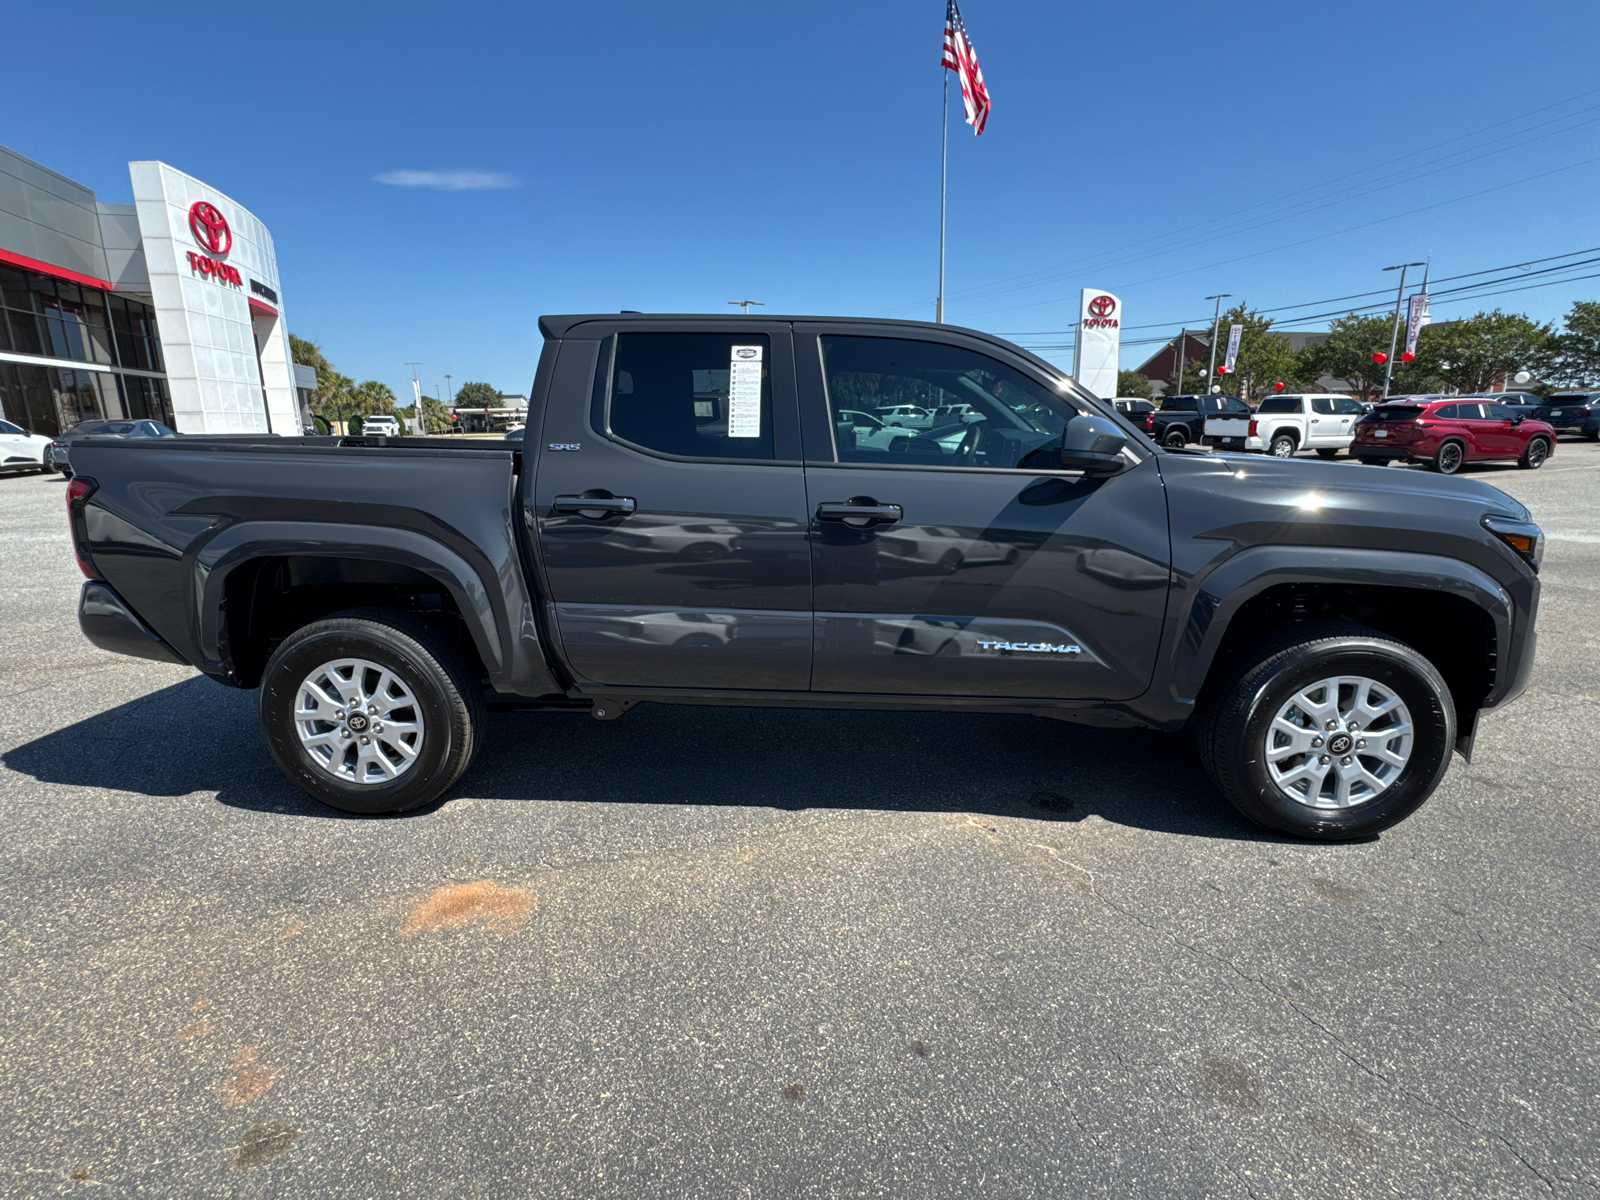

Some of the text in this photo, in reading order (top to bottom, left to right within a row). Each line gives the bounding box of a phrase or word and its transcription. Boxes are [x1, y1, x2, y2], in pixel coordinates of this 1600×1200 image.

[186, 250, 243, 287] TOYOTA
[1083, 318, 1119, 328] TOYOTA
[548, 443, 580, 451] SR5
[976, 640, 1081, 653] TACOMA
